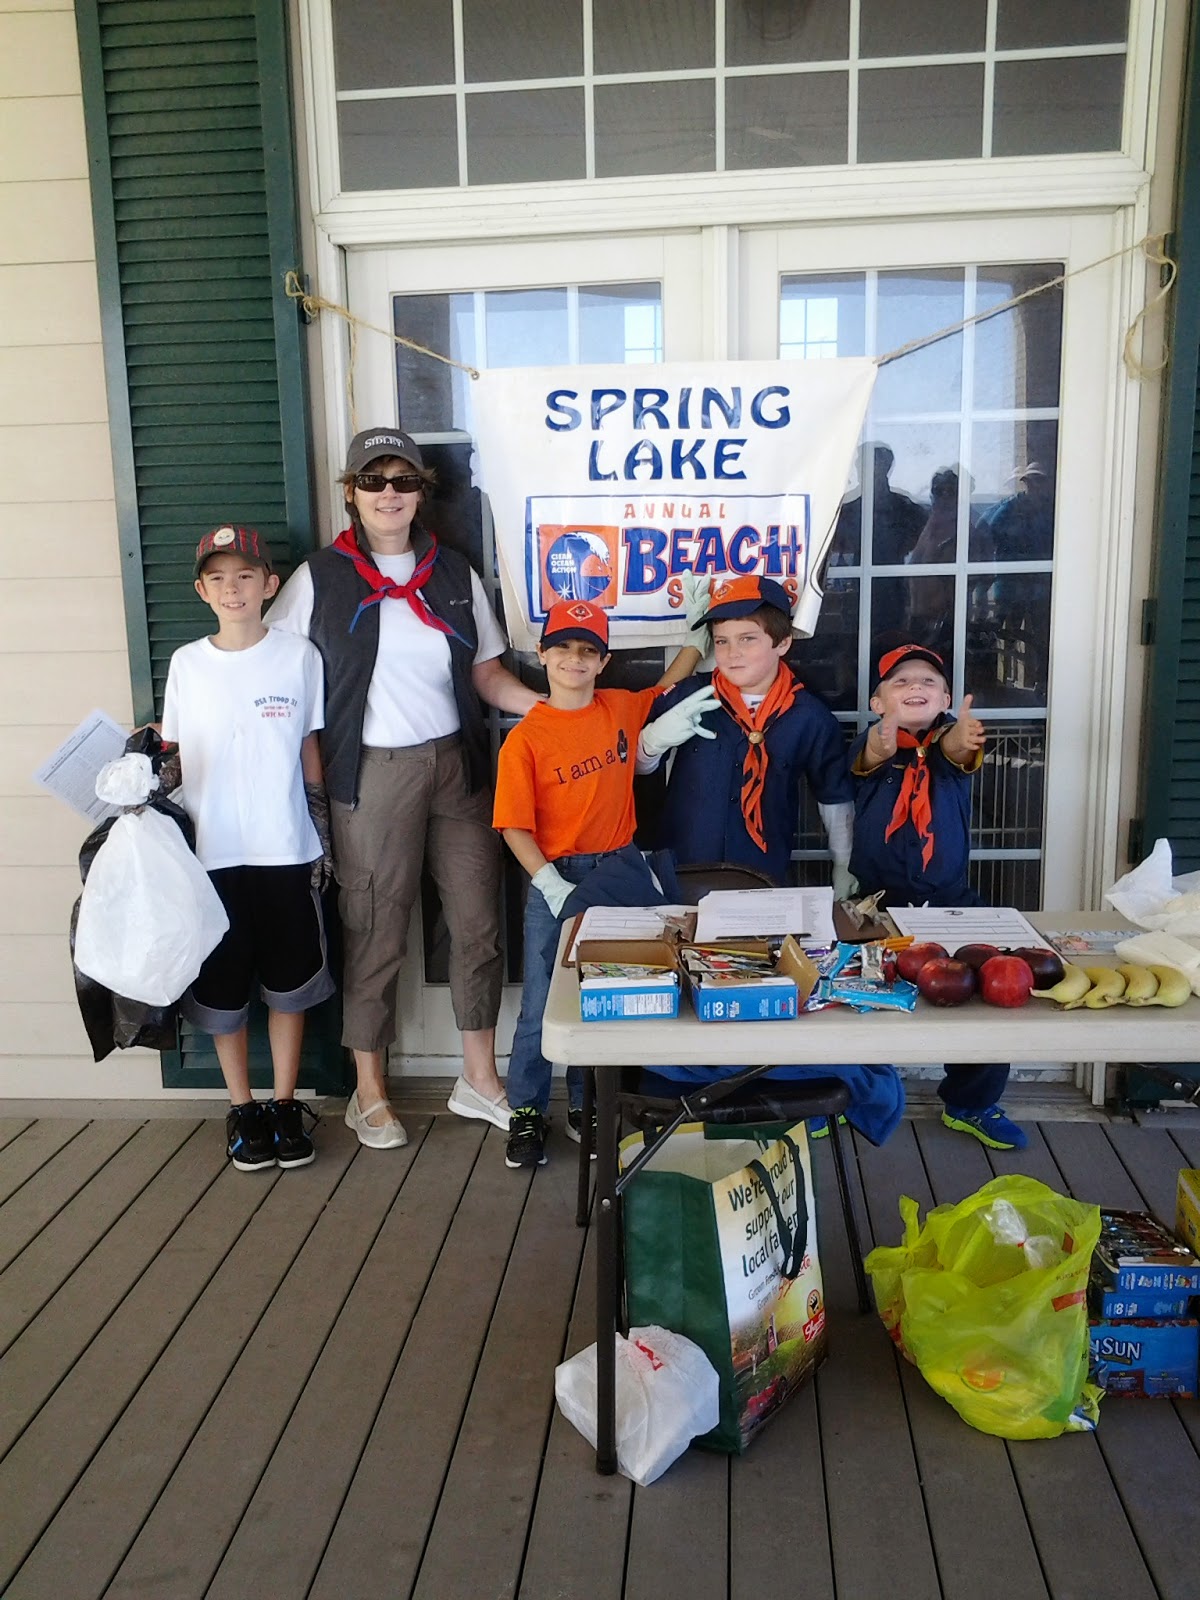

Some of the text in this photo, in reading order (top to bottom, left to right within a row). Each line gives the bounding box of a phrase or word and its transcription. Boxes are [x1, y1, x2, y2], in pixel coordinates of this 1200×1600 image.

[545, 386, 790, 432] SPRING
[588, 439, 748, 481] LAKE
[624, 503, 726, 519] ANNUAL
[622, 525, 802, 595] BEACH
[553, 749, 616, 785] I am a
[727, 1178, 766, 1212] We're
[770, 1146, 788, 1183] roud
[781, 1178, 795, 1205] our
[742, 1236, 769, 1277] local
